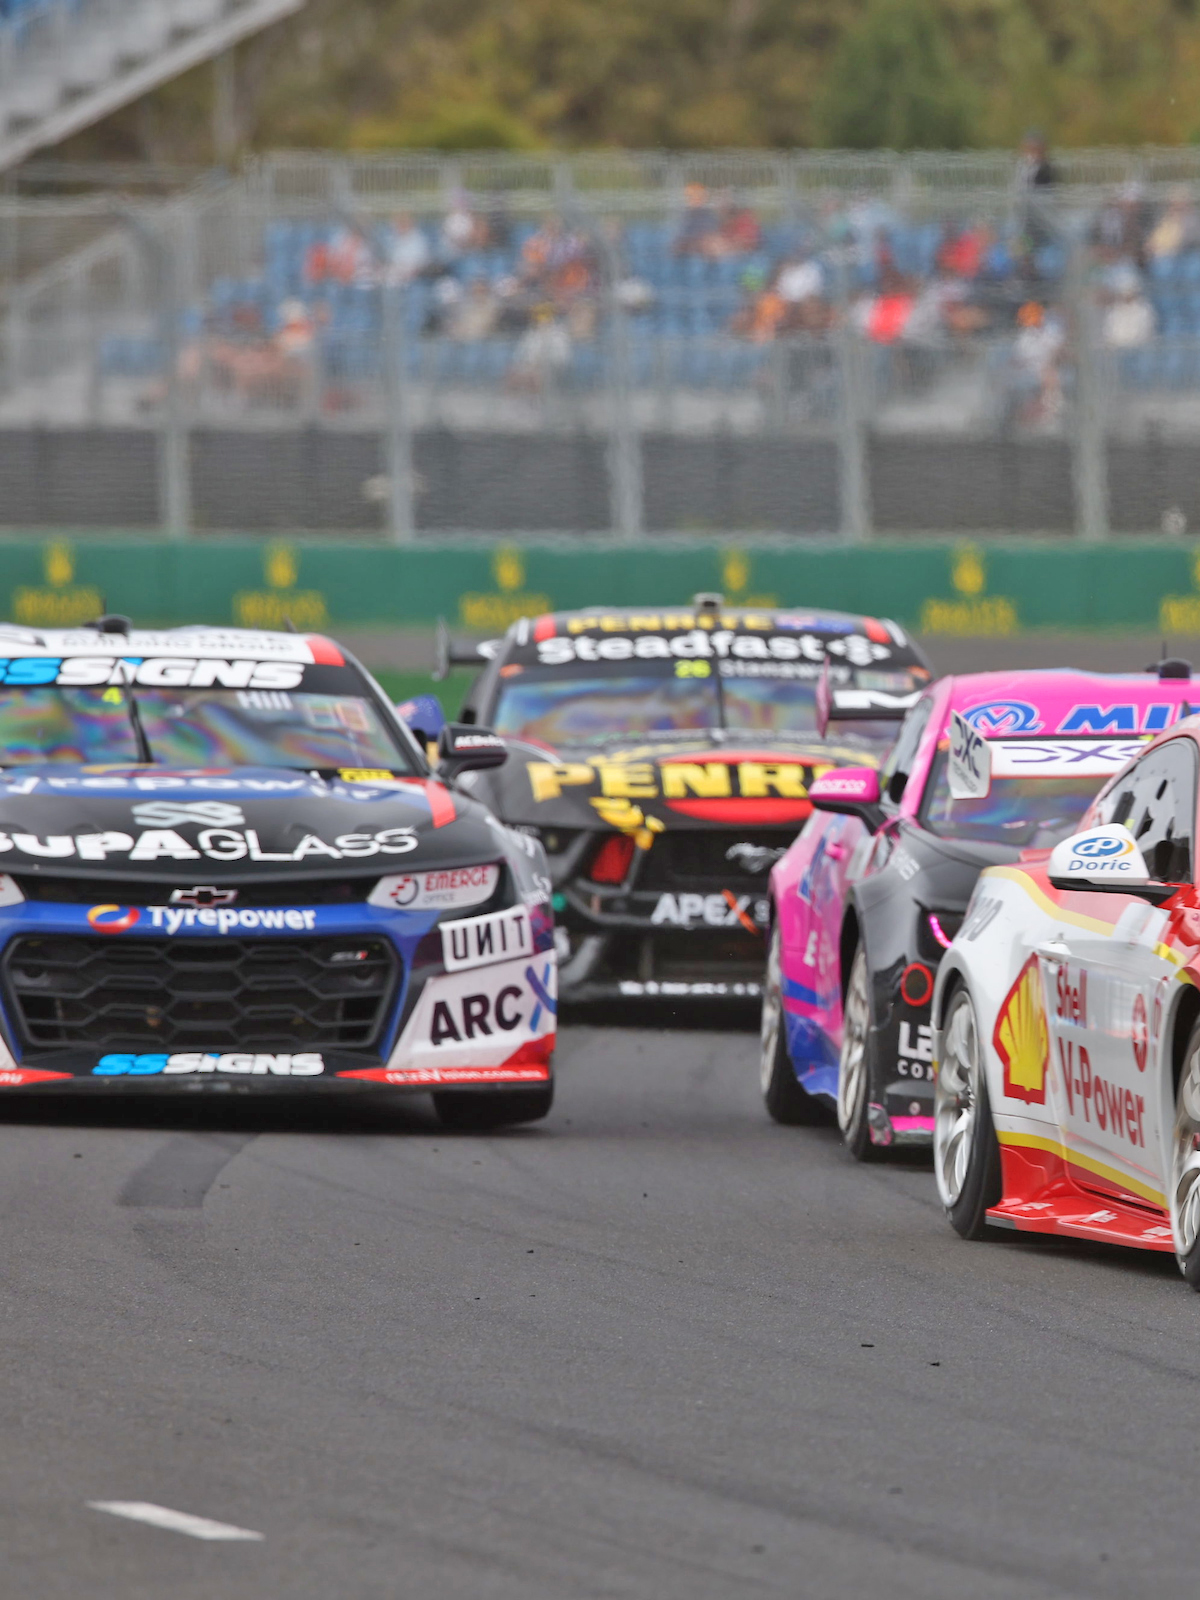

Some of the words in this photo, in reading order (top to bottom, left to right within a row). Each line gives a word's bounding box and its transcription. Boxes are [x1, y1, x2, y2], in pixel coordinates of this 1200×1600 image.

[537, 629, 824, 664] Steadfast
[237, 690, 293, 710] Hill
[424, 866, 490, 892] EMERGE
[1068, 859, 1132, 872] Doric
[147, 906, 317, 934] Tyrepower
[1056, 962, 1088, 1030] Shell
[1058, 1036, 1146, 1149] V-Power
